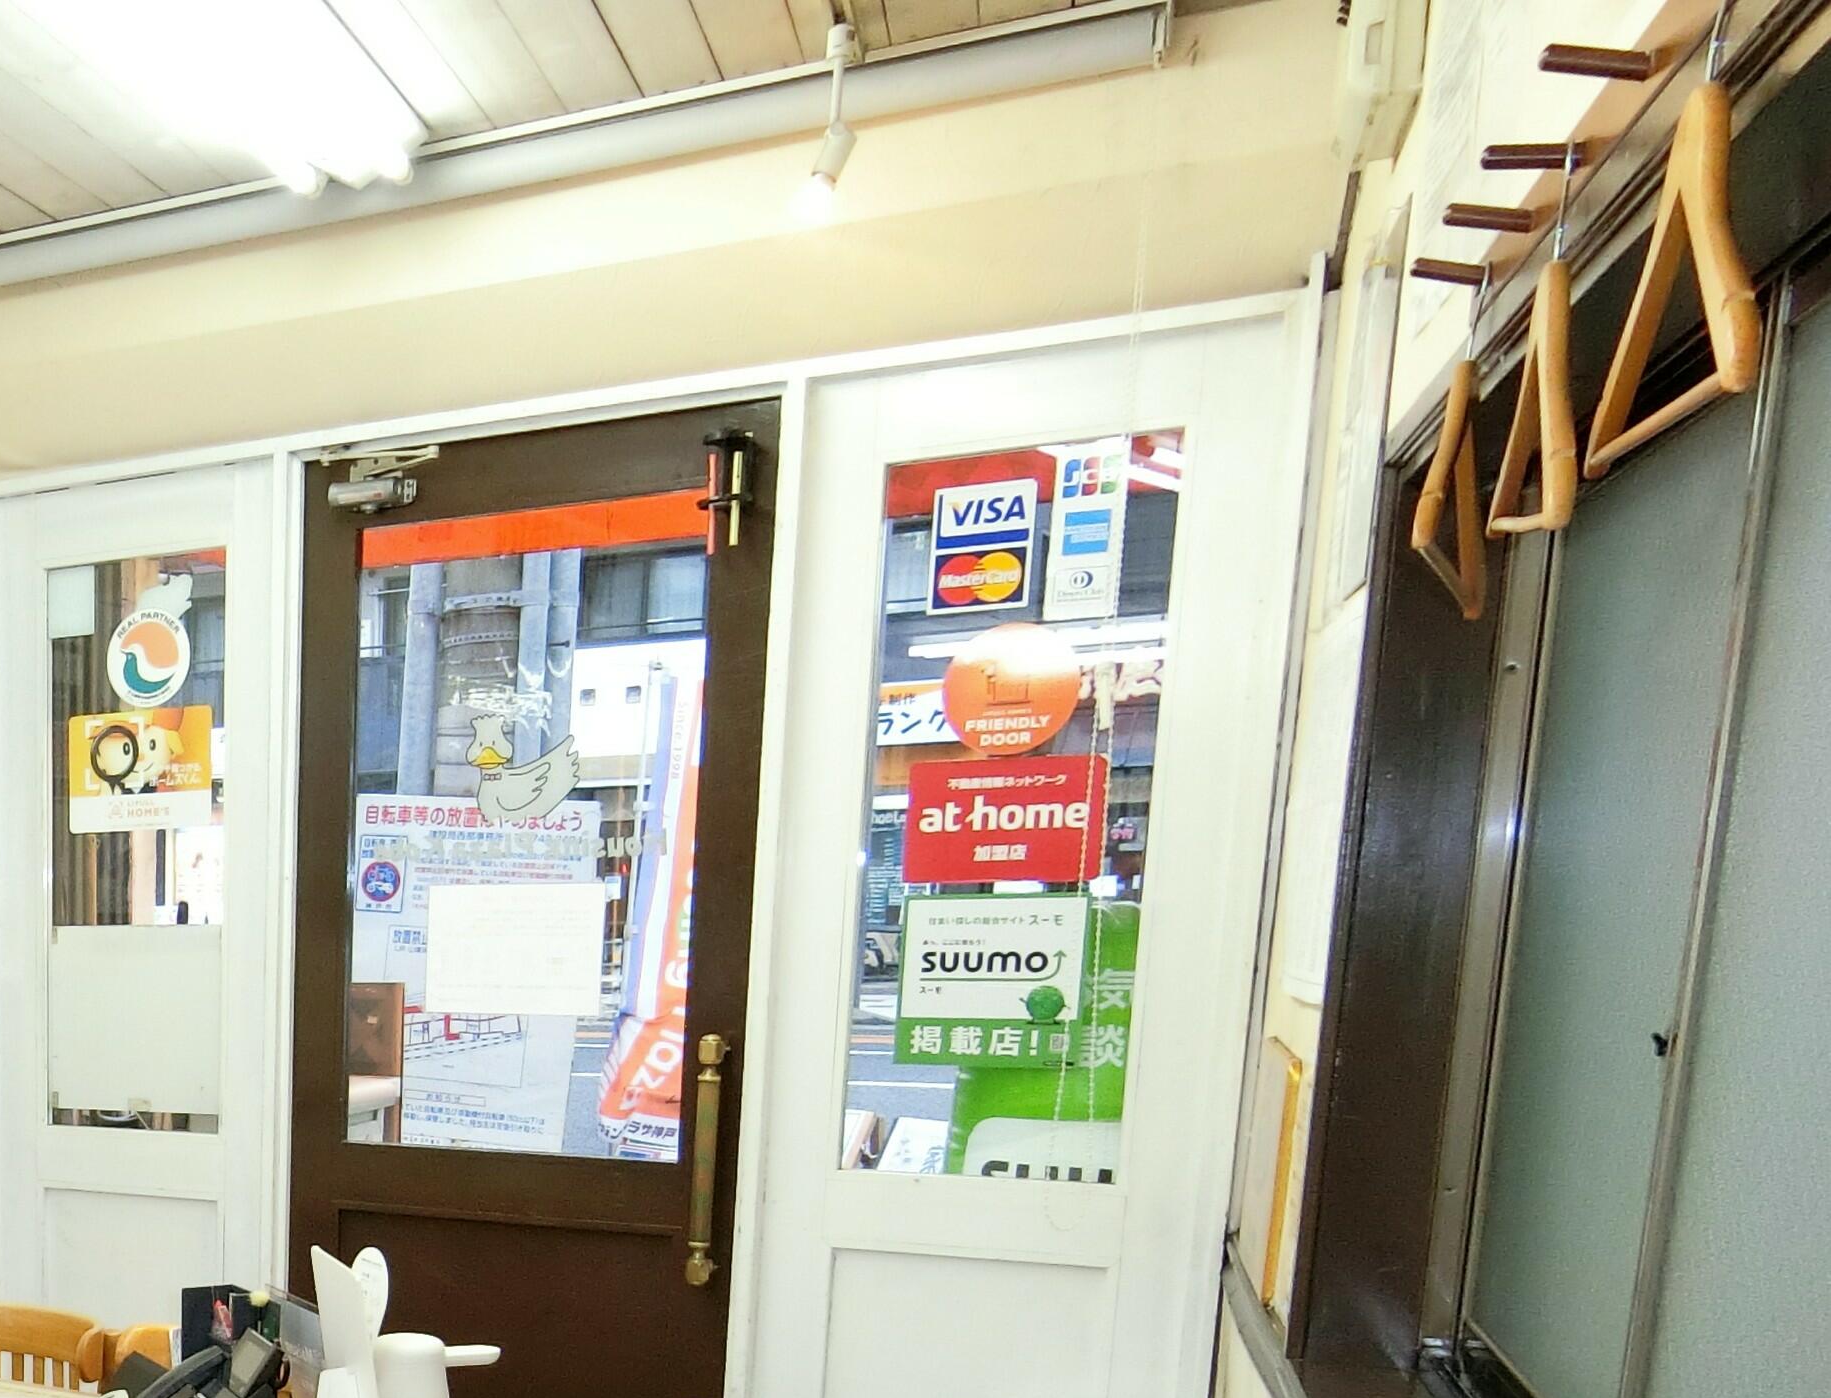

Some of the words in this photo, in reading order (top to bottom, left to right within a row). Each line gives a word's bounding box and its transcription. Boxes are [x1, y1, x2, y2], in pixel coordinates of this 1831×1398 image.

[948, 496, 1026, 527] VISA
[938, 571, 1022, 589] MasterCard
[117, 619, 140, 640] REAL
[140, 612, 181, 634] PARTNER
[964, 715, 1051, 732] FRIENDLY
[979, 732, 1031, 747] DOOR
[919, 802, 962, 833] at
[965, 795, 1090, 832] home
[972, 844, 1028, 862] 加盟店
[1028, 914, 1064, 926] スーモ
